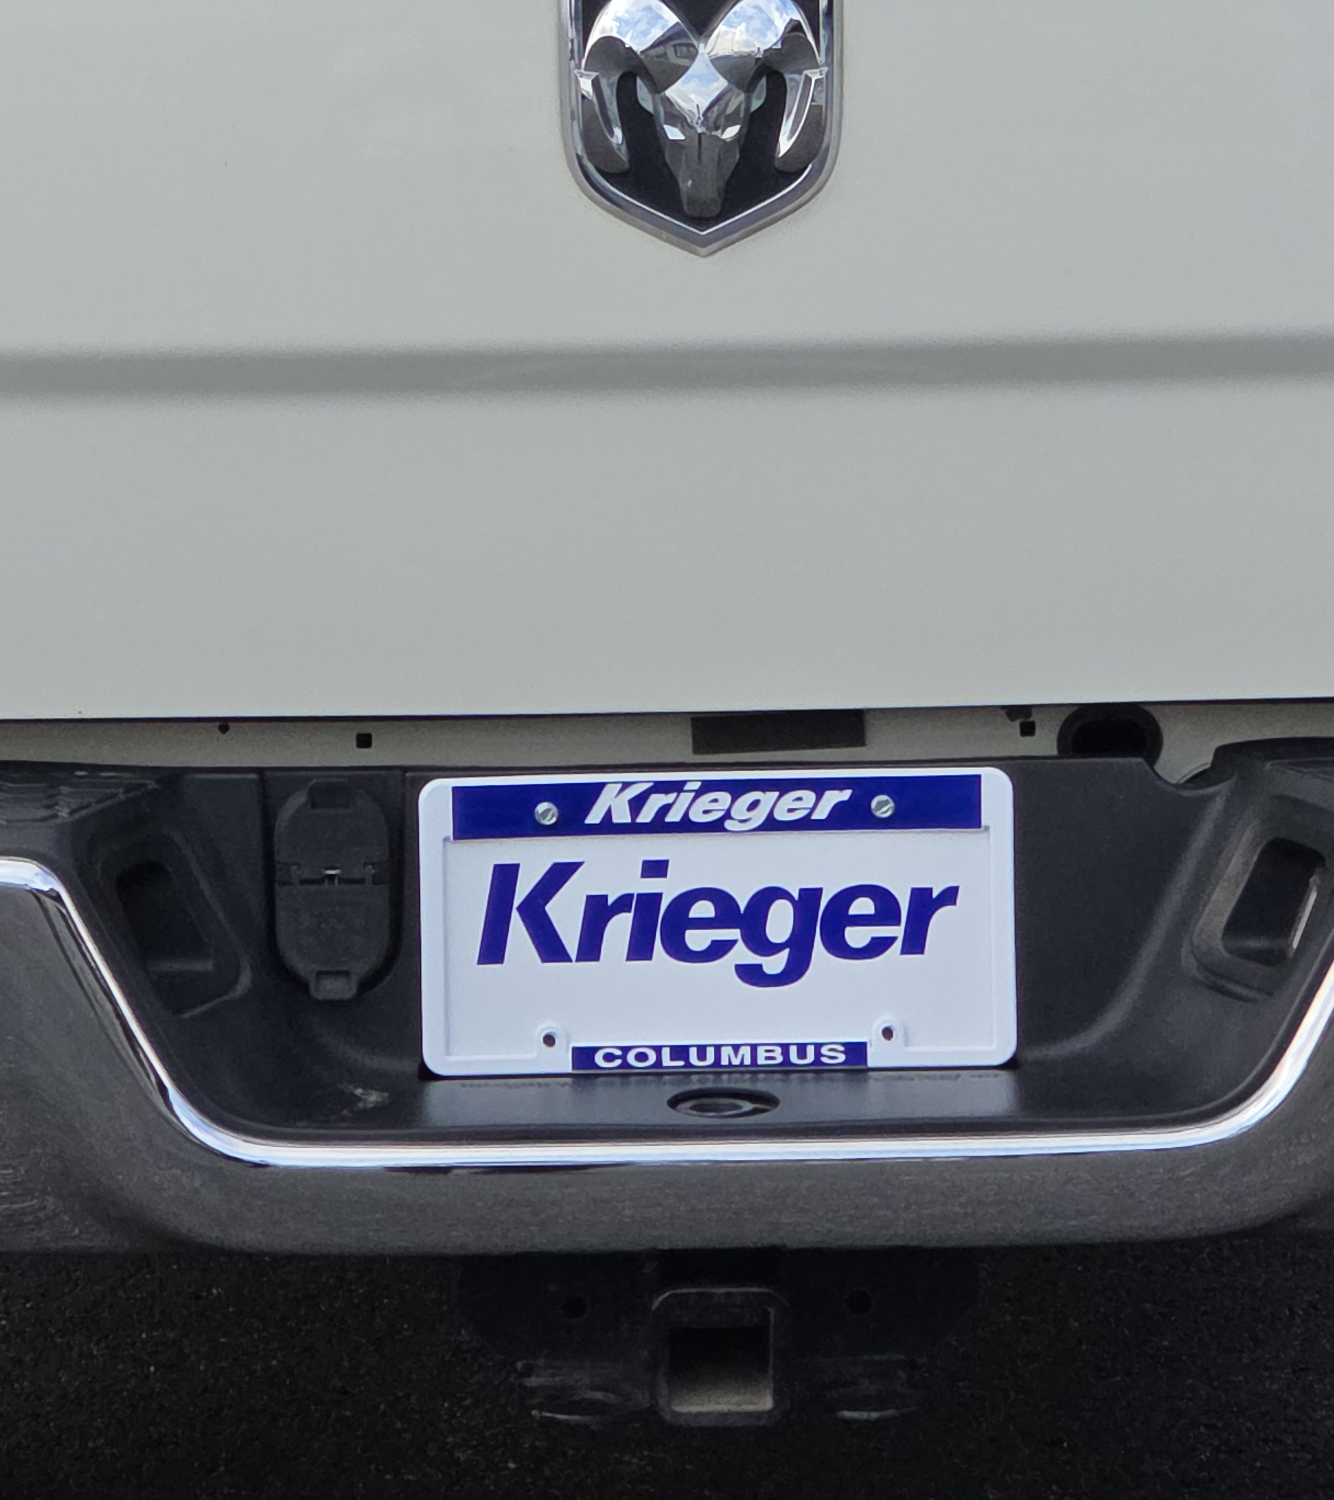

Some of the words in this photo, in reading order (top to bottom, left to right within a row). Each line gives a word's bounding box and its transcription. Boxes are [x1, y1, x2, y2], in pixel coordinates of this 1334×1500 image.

[584, 781, 853, 831] Krieger
[477, 859, 960, 988] Krieger
[594, 1044, 847, 1068] COLUMBUS
